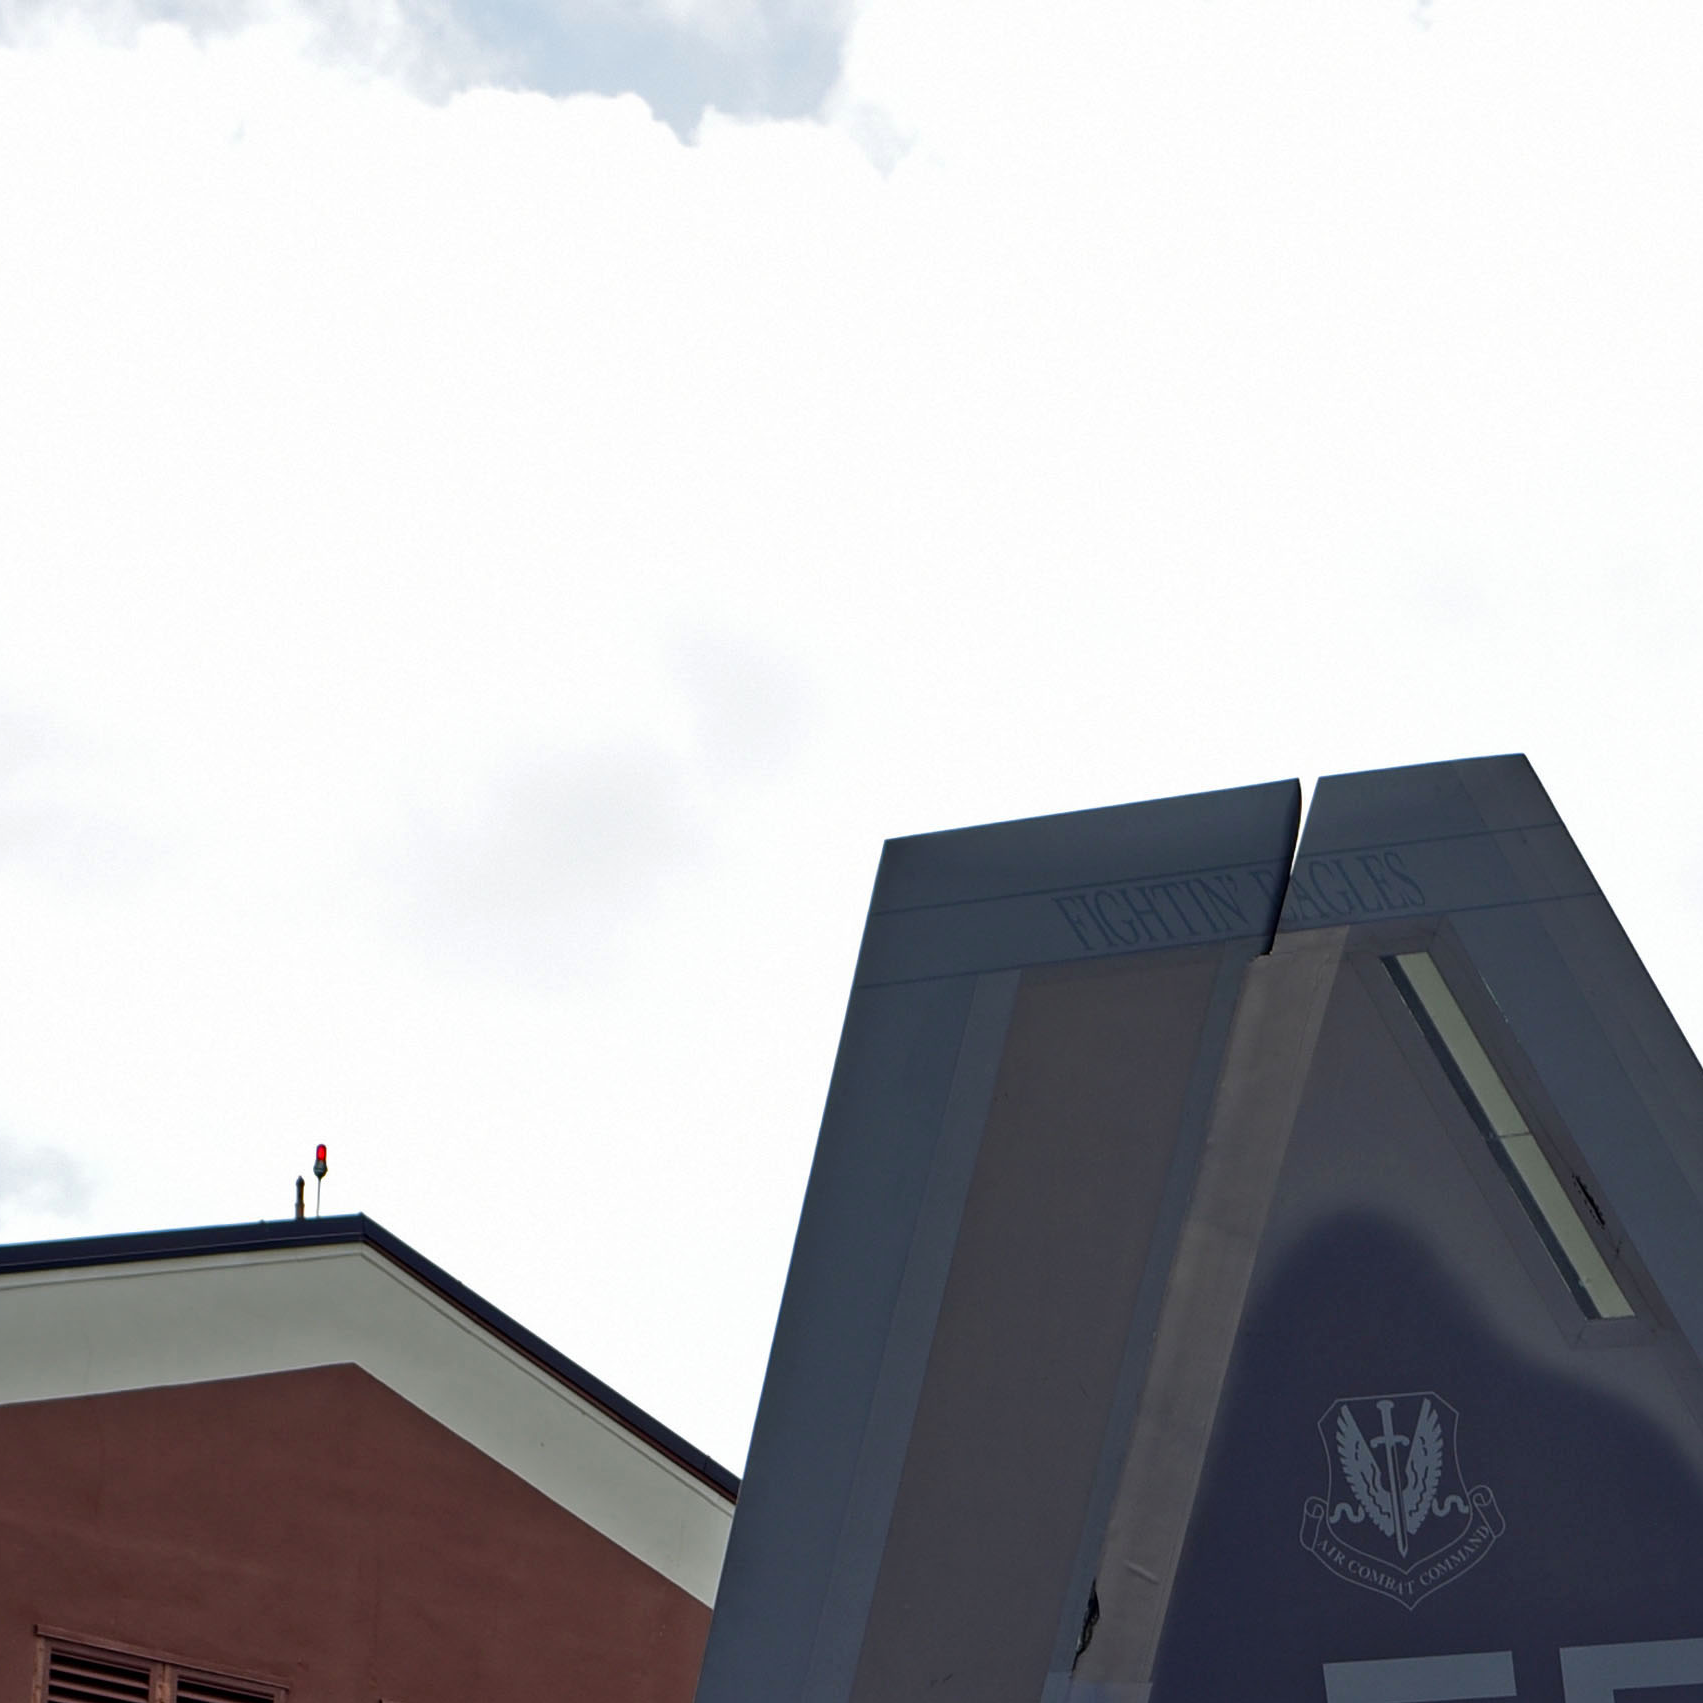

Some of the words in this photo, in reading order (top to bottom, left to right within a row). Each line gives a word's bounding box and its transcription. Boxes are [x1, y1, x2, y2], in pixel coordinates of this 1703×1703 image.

[1316, 1539, 1346, 1565] AIR
[1348, 1559, 1415, 1595] COMBAT
[1418, 1524, 1491, 1586] COMMAND
